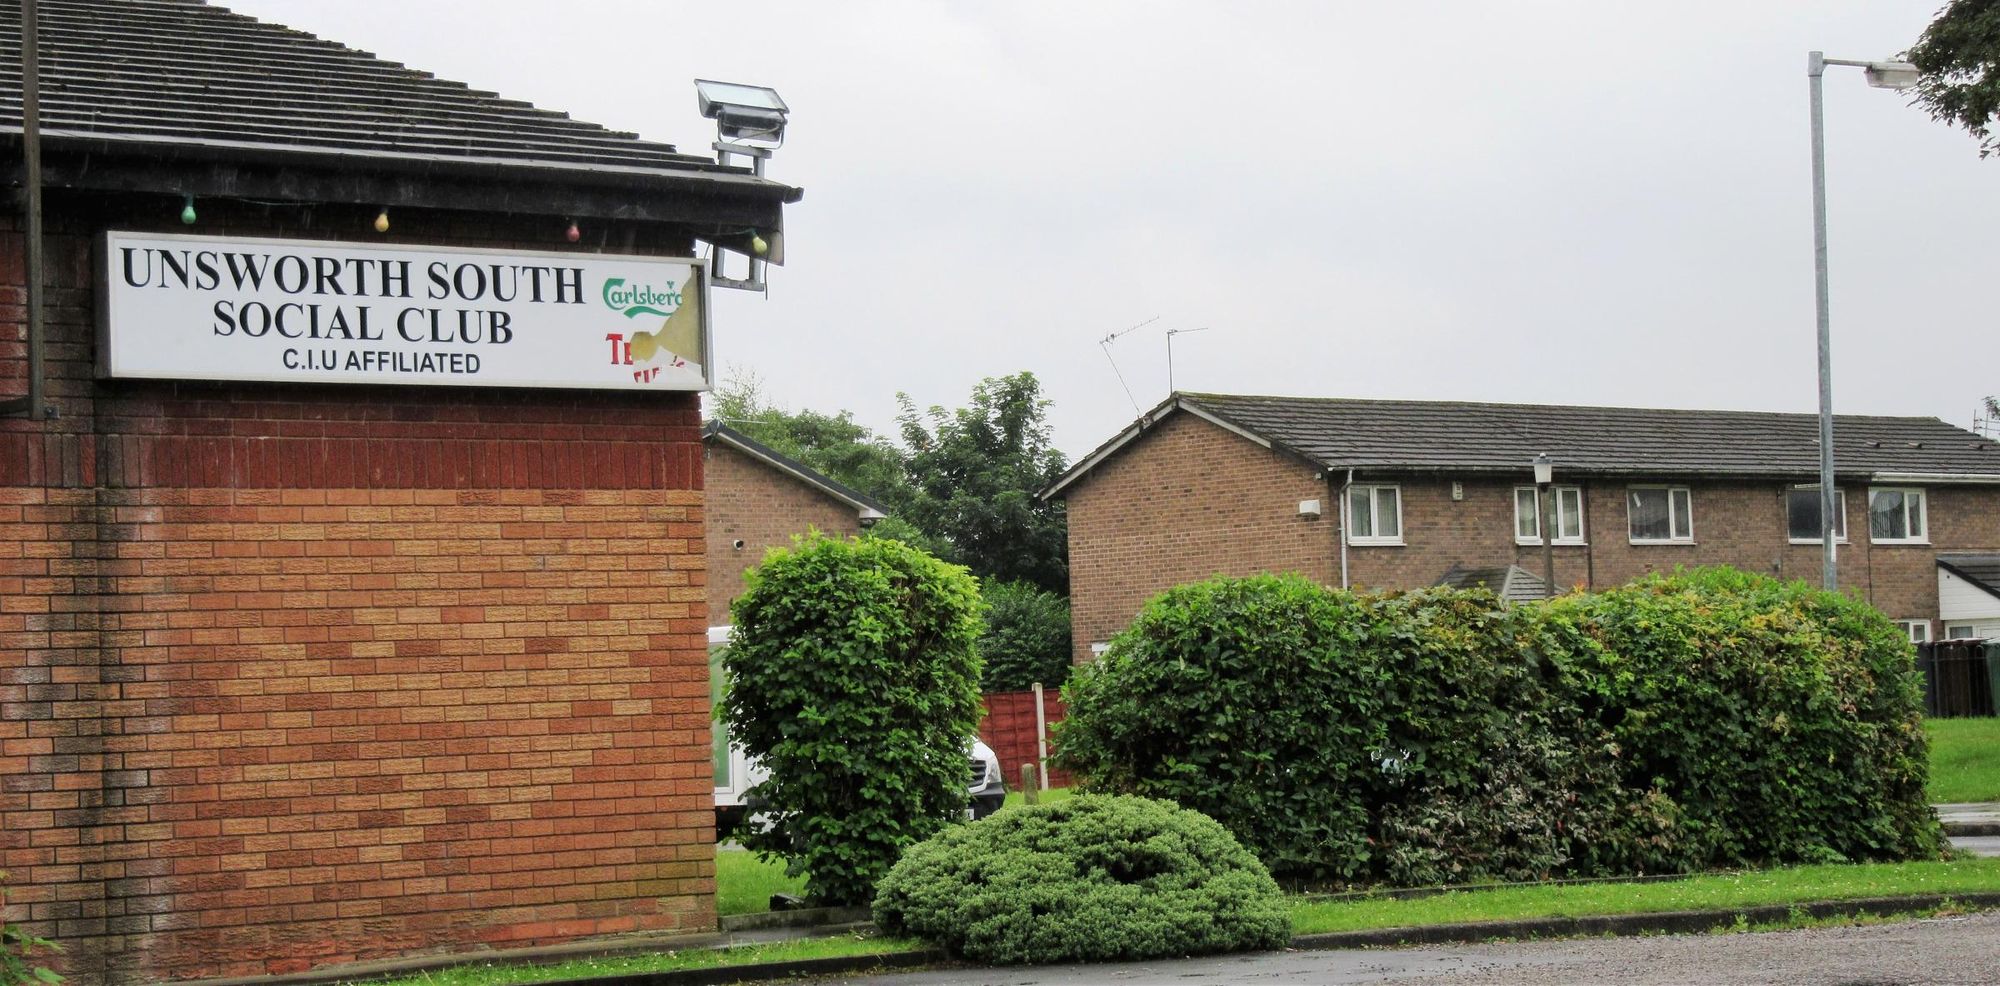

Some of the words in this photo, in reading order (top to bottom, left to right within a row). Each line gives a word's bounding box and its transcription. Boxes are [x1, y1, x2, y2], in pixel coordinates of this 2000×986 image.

[119, 247, 413, 298] UNSWORTH
[427, 261, 585, 304] SOUTH
[213, 300, 384, 341] SOCIAL
[396, 307, 513, 345] CLUB
[282, 349, 337, 371] C.I.U
[344, 351, 481, 375] AFFILIATED
